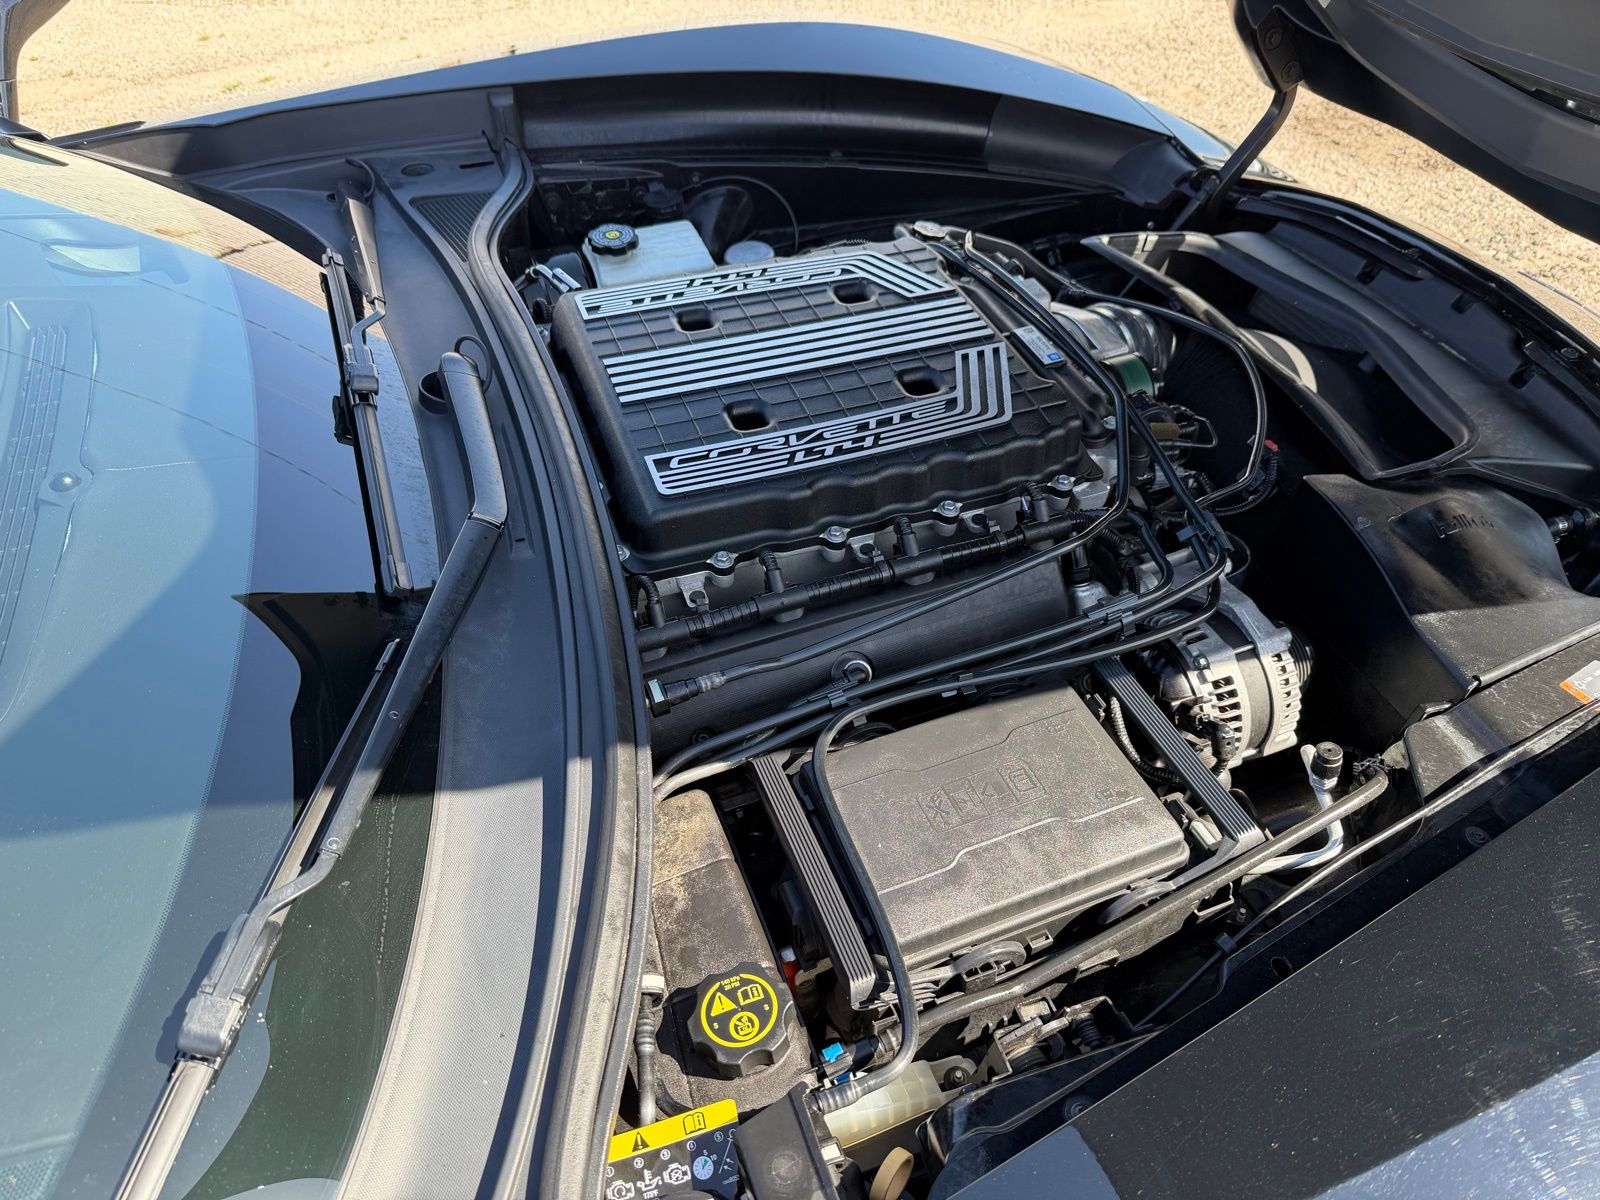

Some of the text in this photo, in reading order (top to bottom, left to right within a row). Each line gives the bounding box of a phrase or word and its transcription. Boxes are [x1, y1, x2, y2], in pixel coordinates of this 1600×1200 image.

[599, 268, 841, 313] CORVETTE
[691, 269, 762, 287] LT4
[669, 400, 948, 471] CORVETTE
[793, 434, 876, 463] LT4
